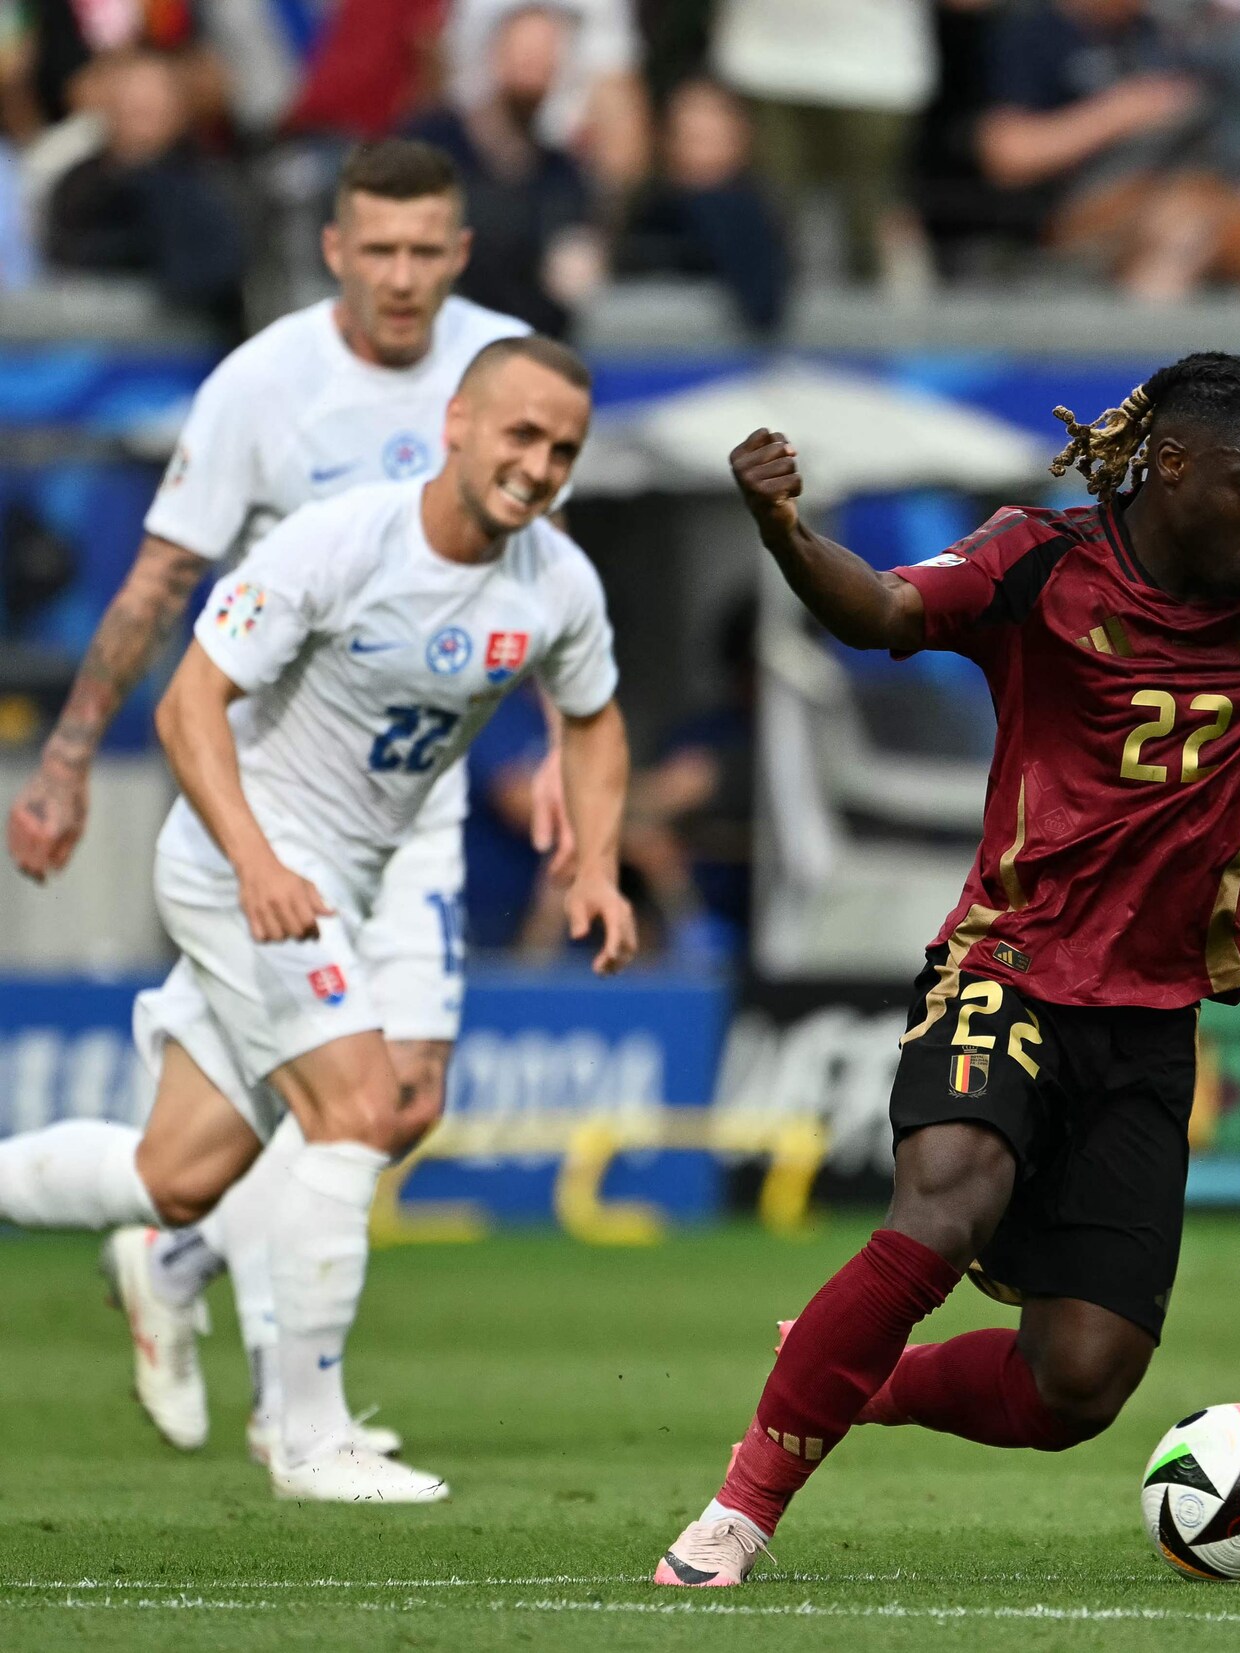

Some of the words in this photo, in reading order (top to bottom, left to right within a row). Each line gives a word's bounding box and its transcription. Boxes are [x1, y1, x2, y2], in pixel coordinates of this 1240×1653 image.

[368, 704, 460, 772] 22
[1120, 689, 1233, 783] 22
[950, 980, 1043, 1080] 22
